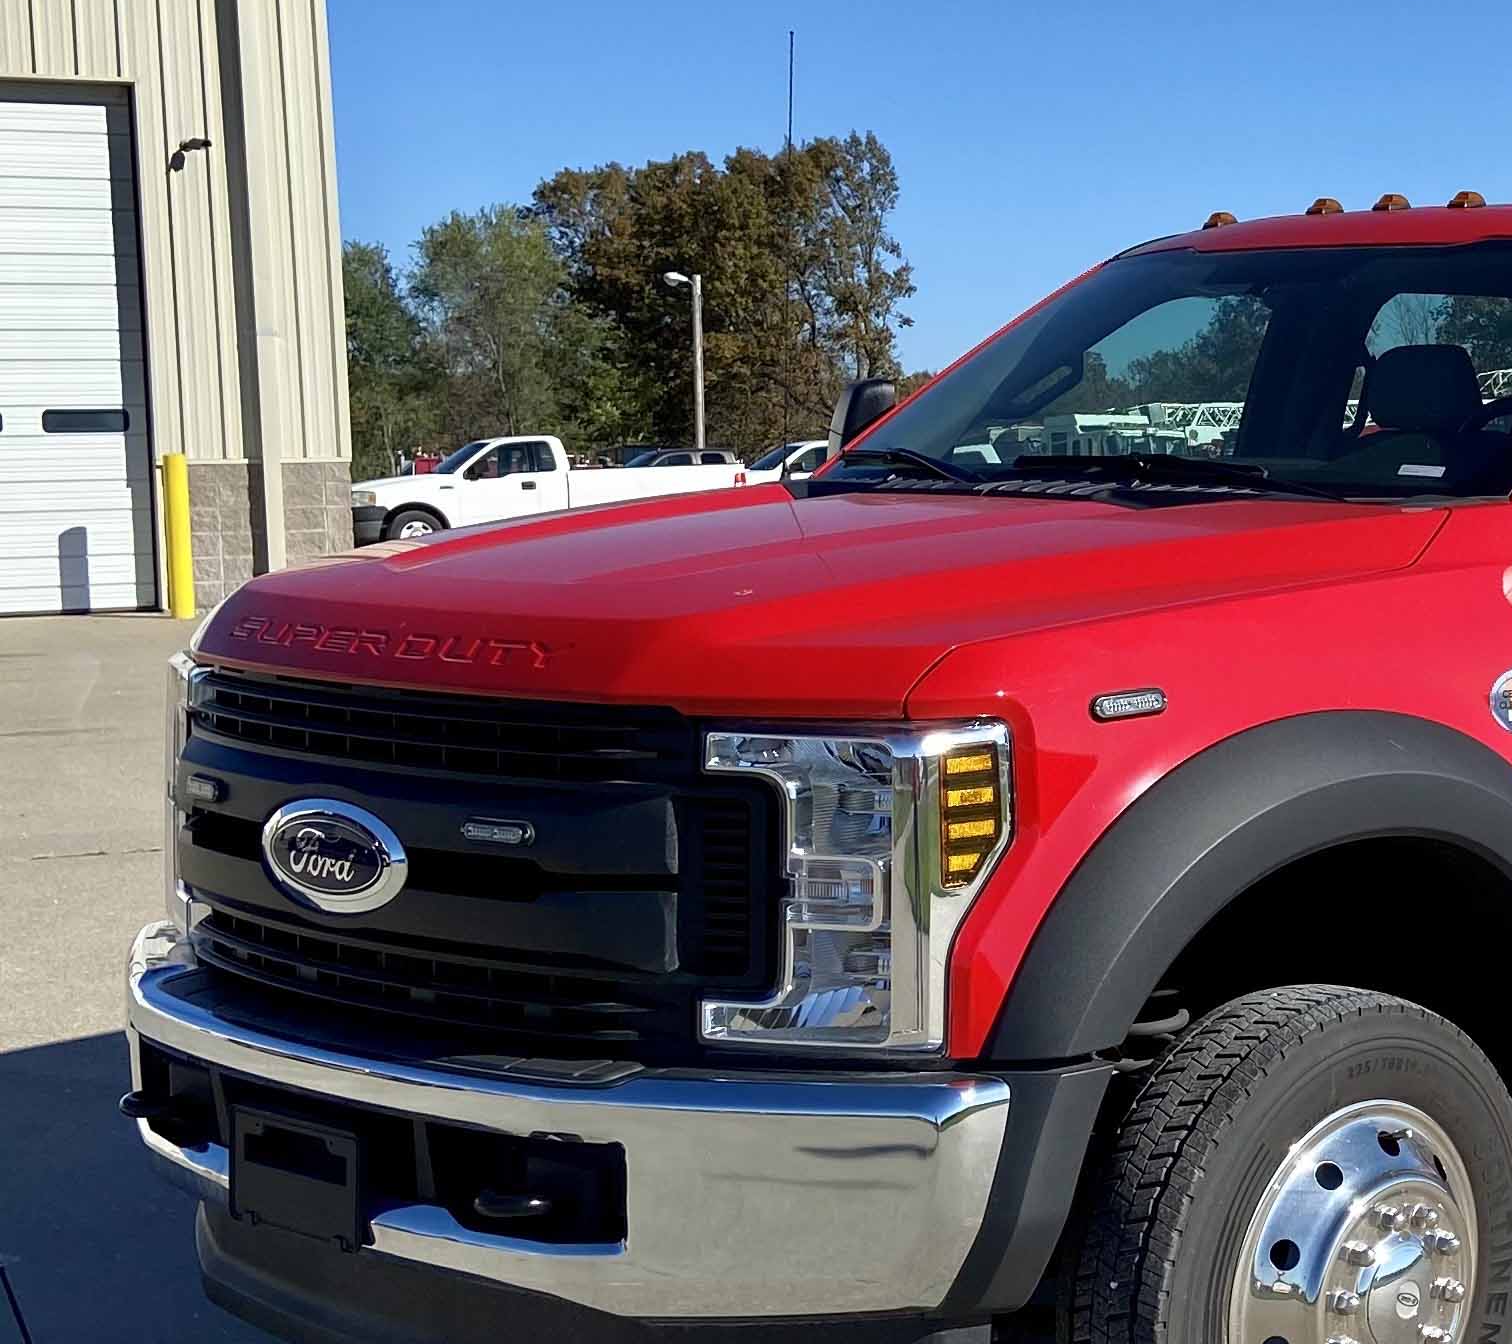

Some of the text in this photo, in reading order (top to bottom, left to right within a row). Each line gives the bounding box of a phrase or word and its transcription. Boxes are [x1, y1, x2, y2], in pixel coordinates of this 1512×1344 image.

[230, 615, 554, 669] SUPER DUTY
[289, 827, 355, 882] Ford
